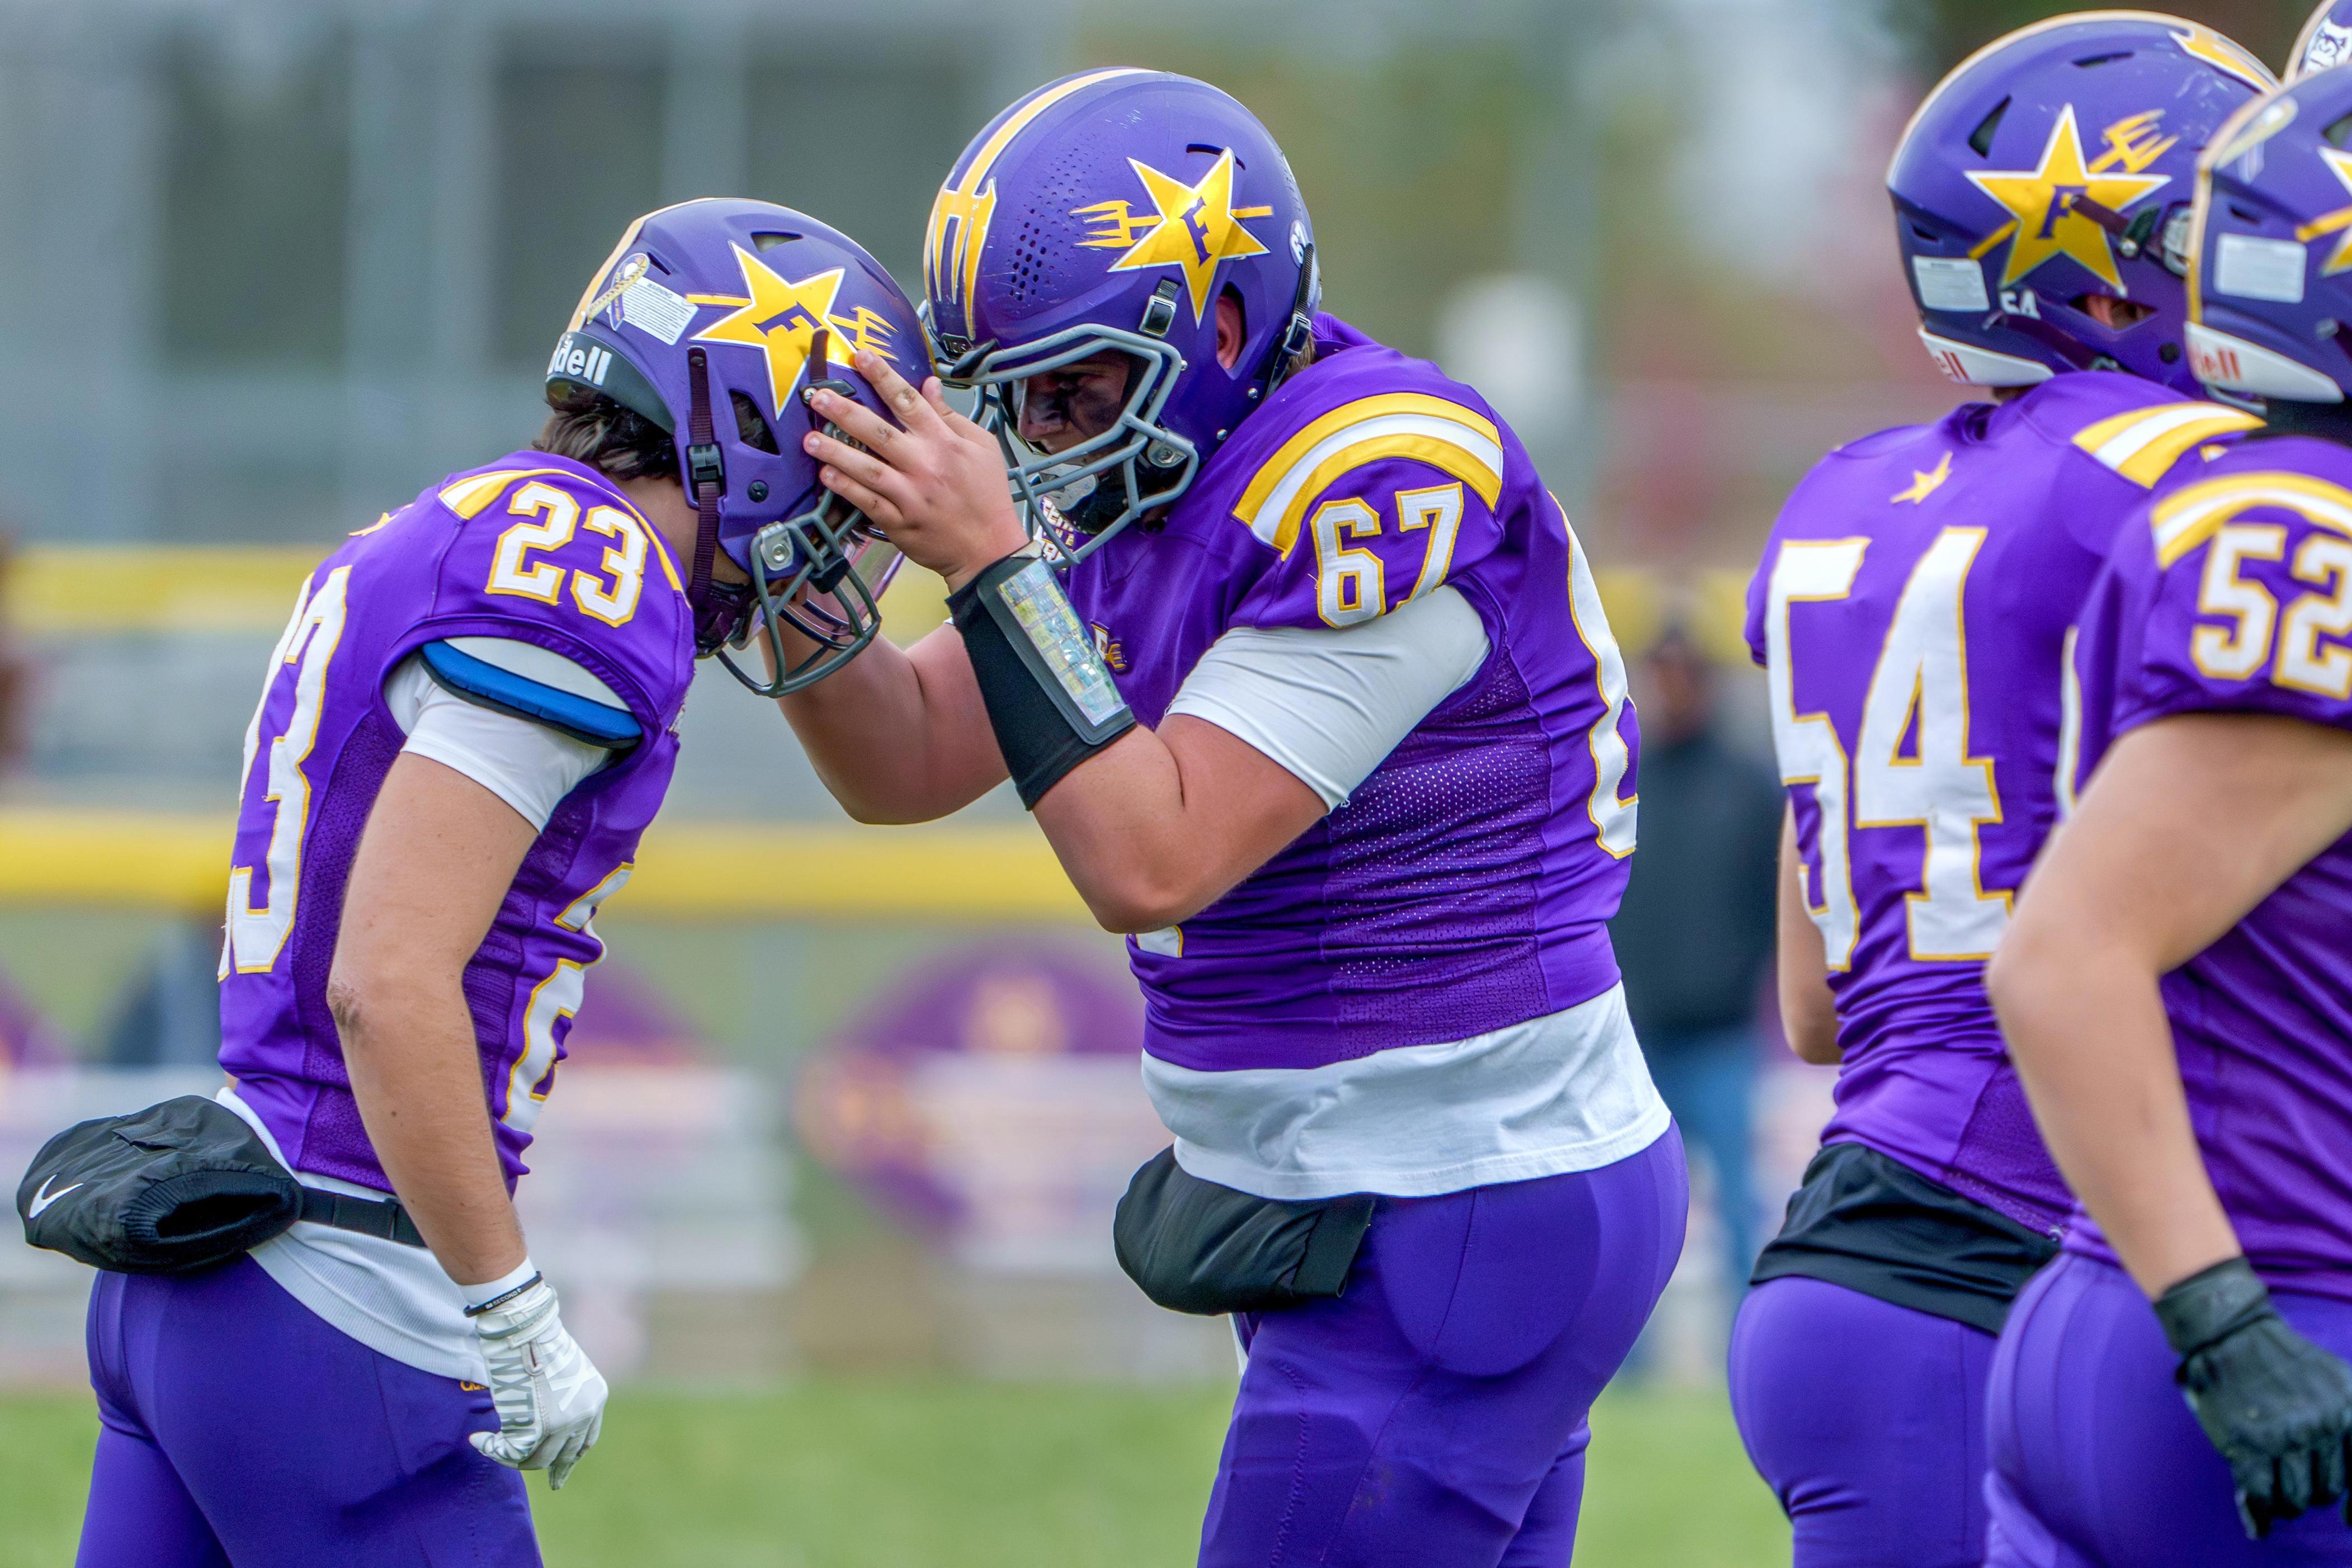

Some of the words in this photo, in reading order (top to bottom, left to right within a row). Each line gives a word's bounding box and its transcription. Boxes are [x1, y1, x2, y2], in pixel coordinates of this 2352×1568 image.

[1179, 196, 1212, 268] F
[2036, 185, 2088, 239] F
[547, 341, 612, 386] dell
[751, 300, 822, 337] F
[485, 480, 649, 628] 23
[1310, 481, 1463, 629] 67
[2189, 523, 2352, 702] 52
[217, 564, 352, 983] 3
[1764, 526, 2015, 972] 54
